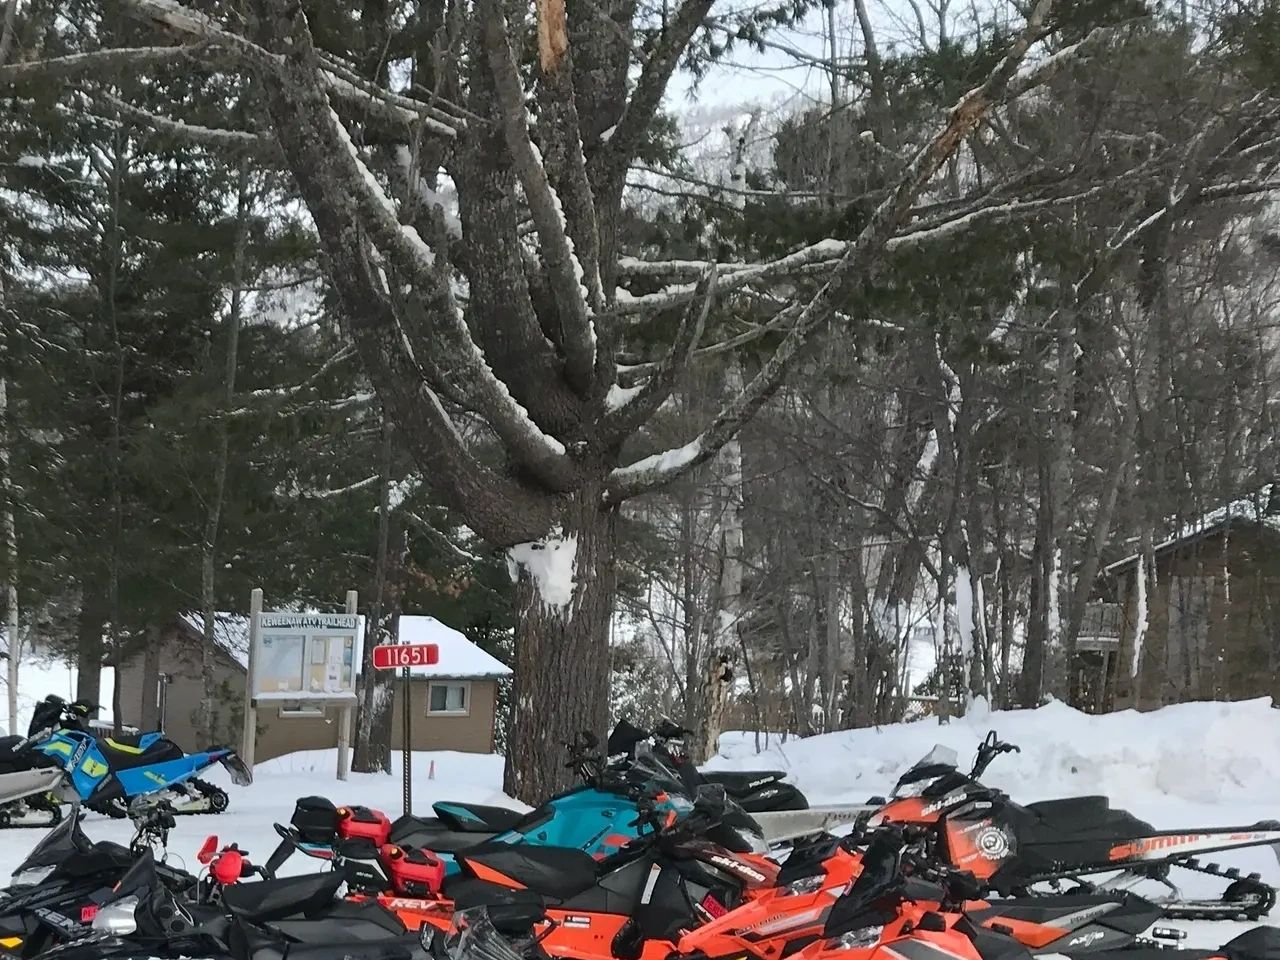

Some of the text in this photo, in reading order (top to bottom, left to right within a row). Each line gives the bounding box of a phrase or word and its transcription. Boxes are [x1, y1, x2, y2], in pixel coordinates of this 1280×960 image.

[386, 648, 428, 665] 11651
[920, 792, 967, 817] ski-doo
[710, 854, 767, 883] ski-doo
[390, 898, 437, 909] REV
[1069, 931, 1105, 947] AXYS
